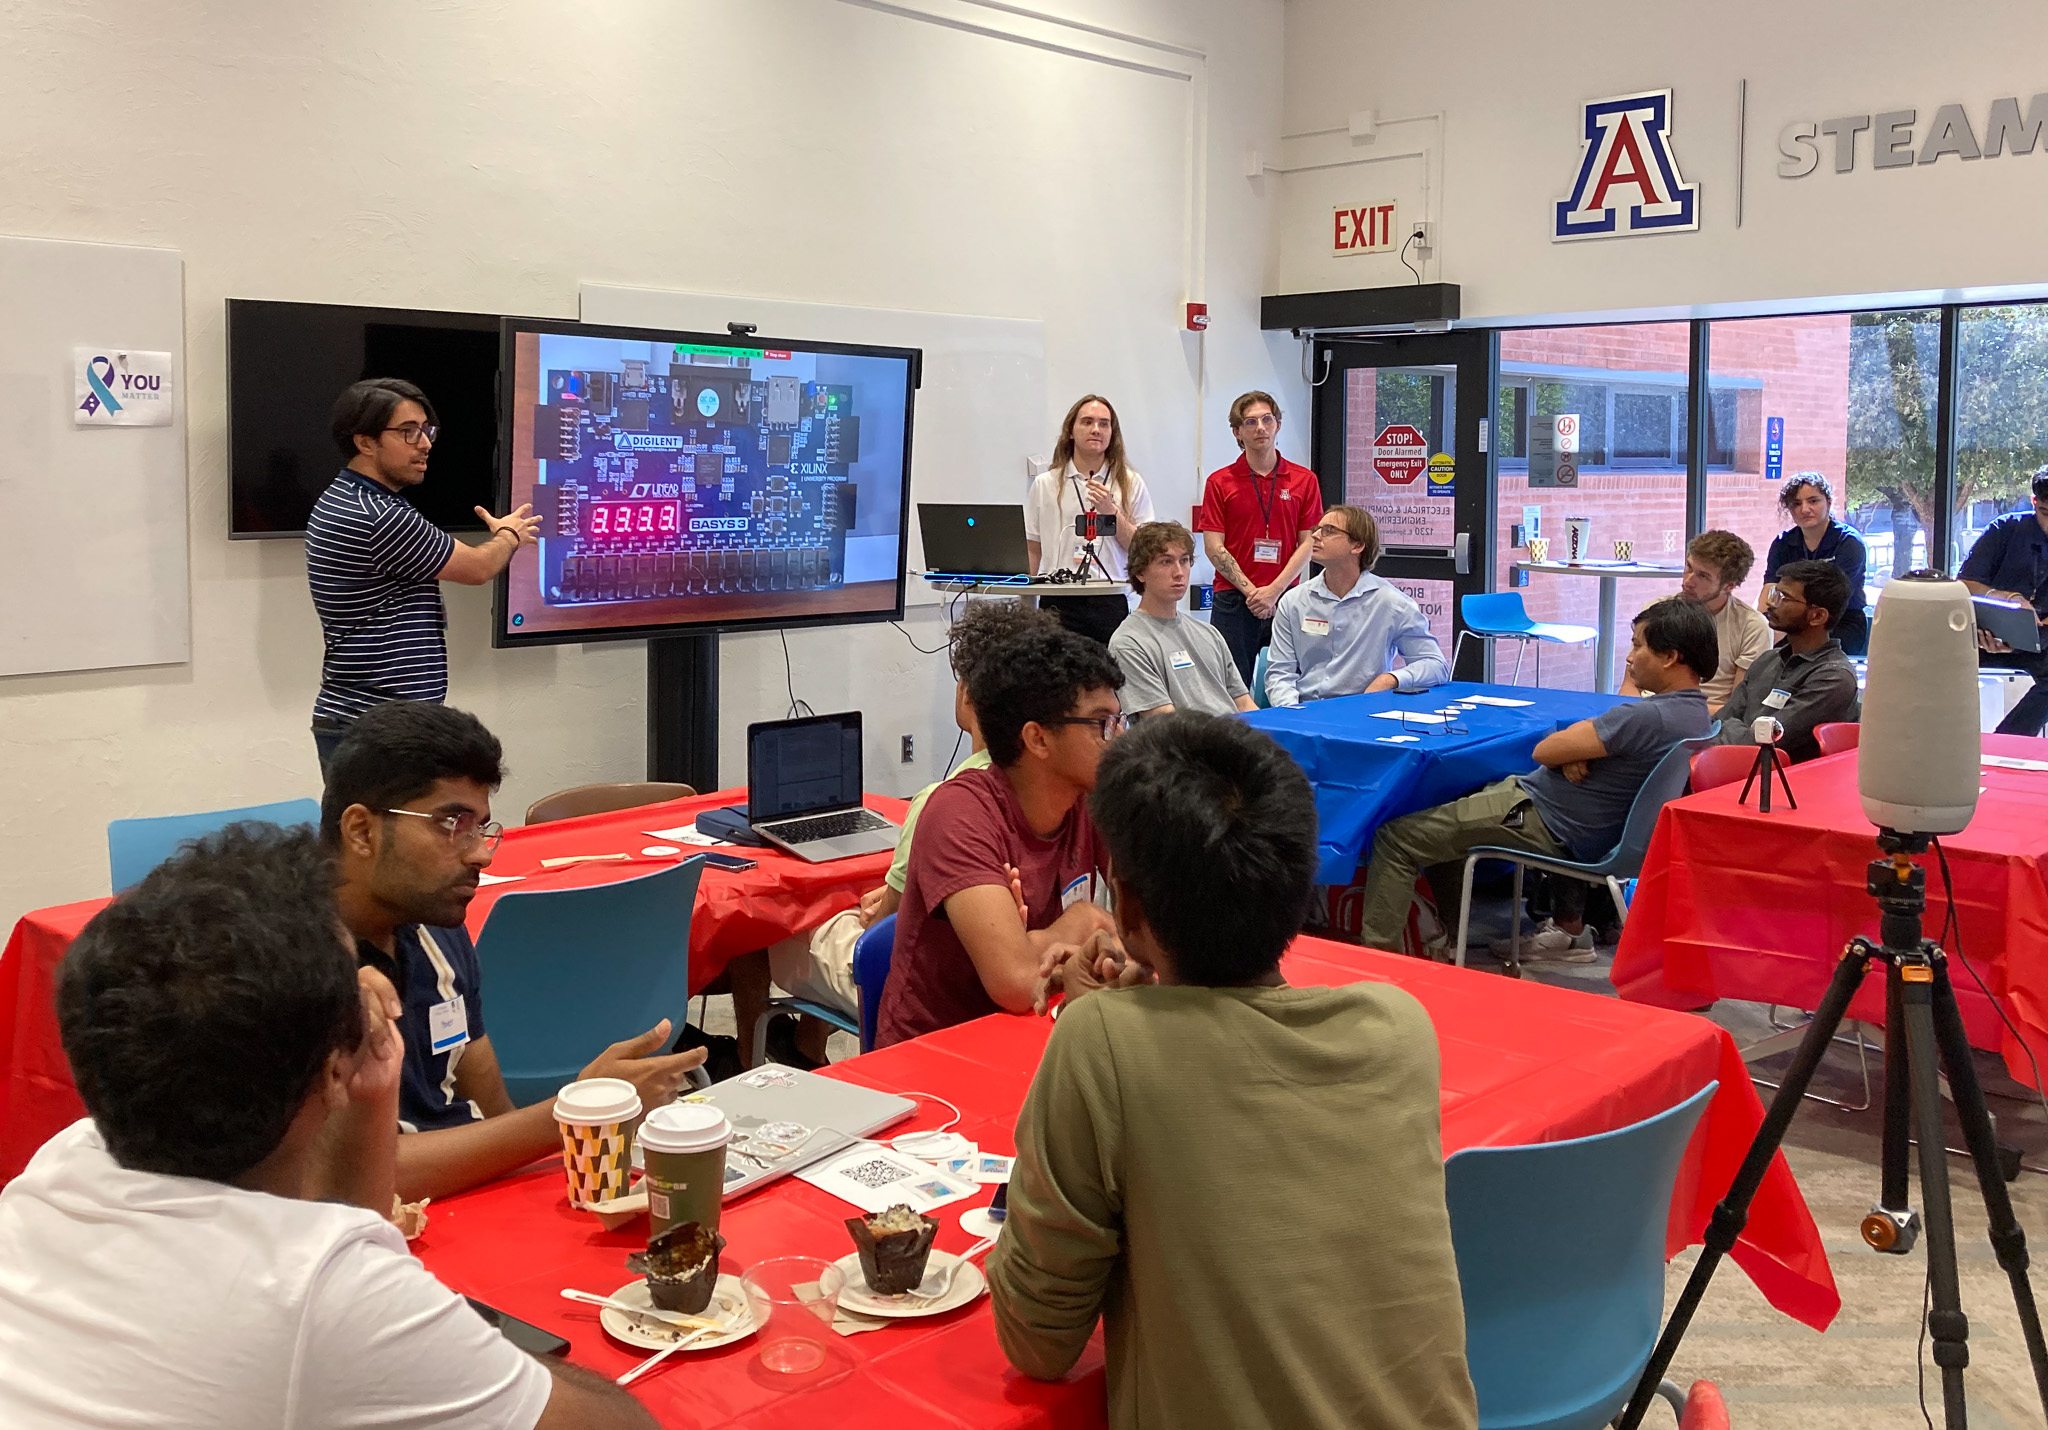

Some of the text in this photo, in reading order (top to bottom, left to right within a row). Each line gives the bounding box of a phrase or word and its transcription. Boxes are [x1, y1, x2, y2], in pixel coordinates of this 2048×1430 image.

[1777, 93, 2048, 177] STEAM
[1552, 88, 1700, 242] A
[1334, 204, 1395, 250] EXIT
[121, 374, 160, 391] YOU
[121, 392, 160, 400] MATTER
[633, 436, 678, 446] DIGILENT
[1386, 433, 1413, 445] STOP!
[1378, 447, 1422, 456] Door Alarmed
[800, 463, 829, 474] XILINX
[1376, 459, 1423, 468] Emergency Exit
[1390, 470, 1409, 479] ONLY
[691, 519, 747, 530] BASYS 3
[1571, 525, 1579, 560] ARIZONA
